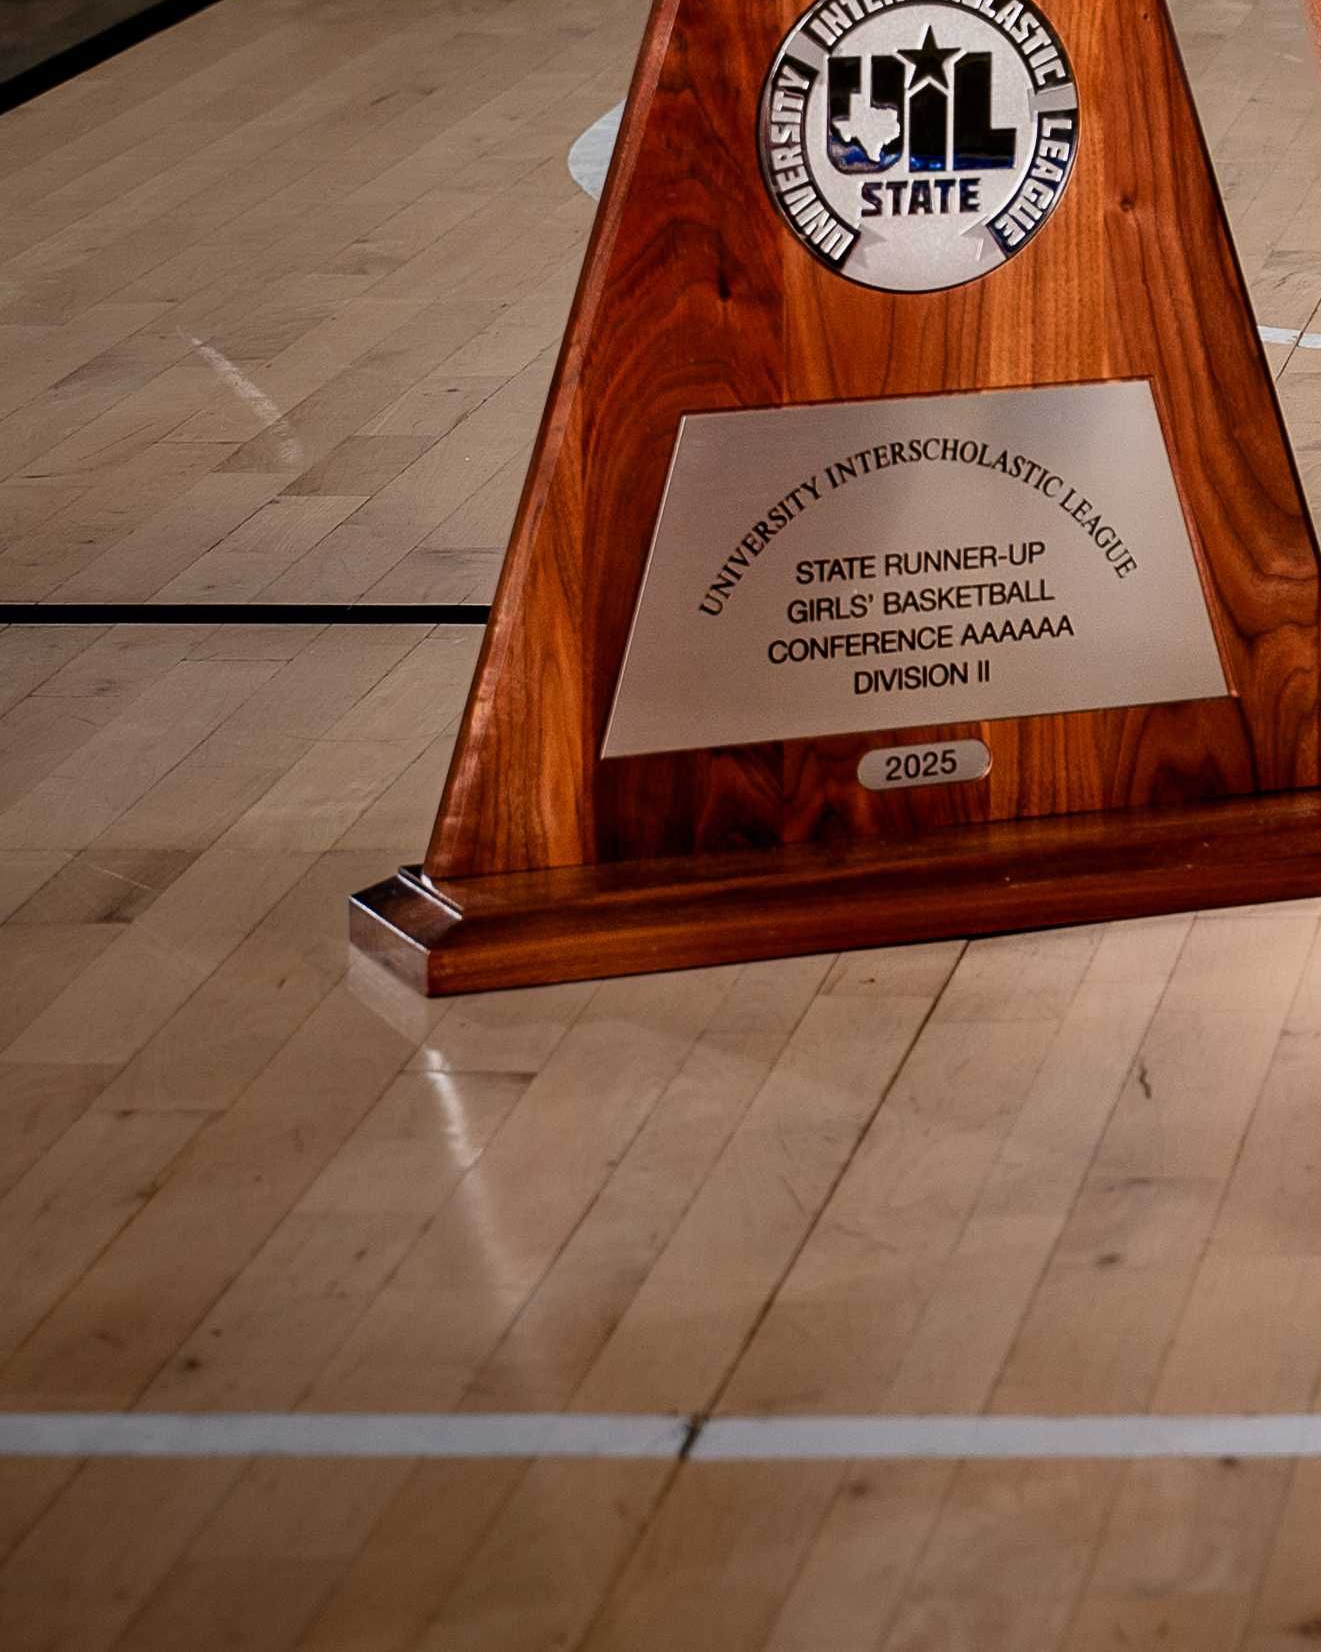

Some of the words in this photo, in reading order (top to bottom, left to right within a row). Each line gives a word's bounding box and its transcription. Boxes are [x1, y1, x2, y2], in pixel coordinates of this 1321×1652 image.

[827, 49, 1017, 175] UIL
[771, 65, 855, 261] UNIVERSITY
[995, 117, 1073, 247] LEAGUE
[860, 178, 981, 217] STATE
[699, 476, 822, 618] UNIVERSITY
[825, 437, 1063, 498] INTERSCHOLASTIC
[1059, 488, 1138, 580] LEAGUE
[795, 555, 876, 585] STATE
[884, 541, 1046, 576] RUNNER-UP
[883, 579, 1055, 615] BASKETBALL
[767, 625, 953, 664] CONFERENCE
[960, 615, 1075, 646] AAAAAA
[854, 661, 969, 694] DIVISION
[977, 659, 991, 682] II
[884, 749, 958, 781] 2025
